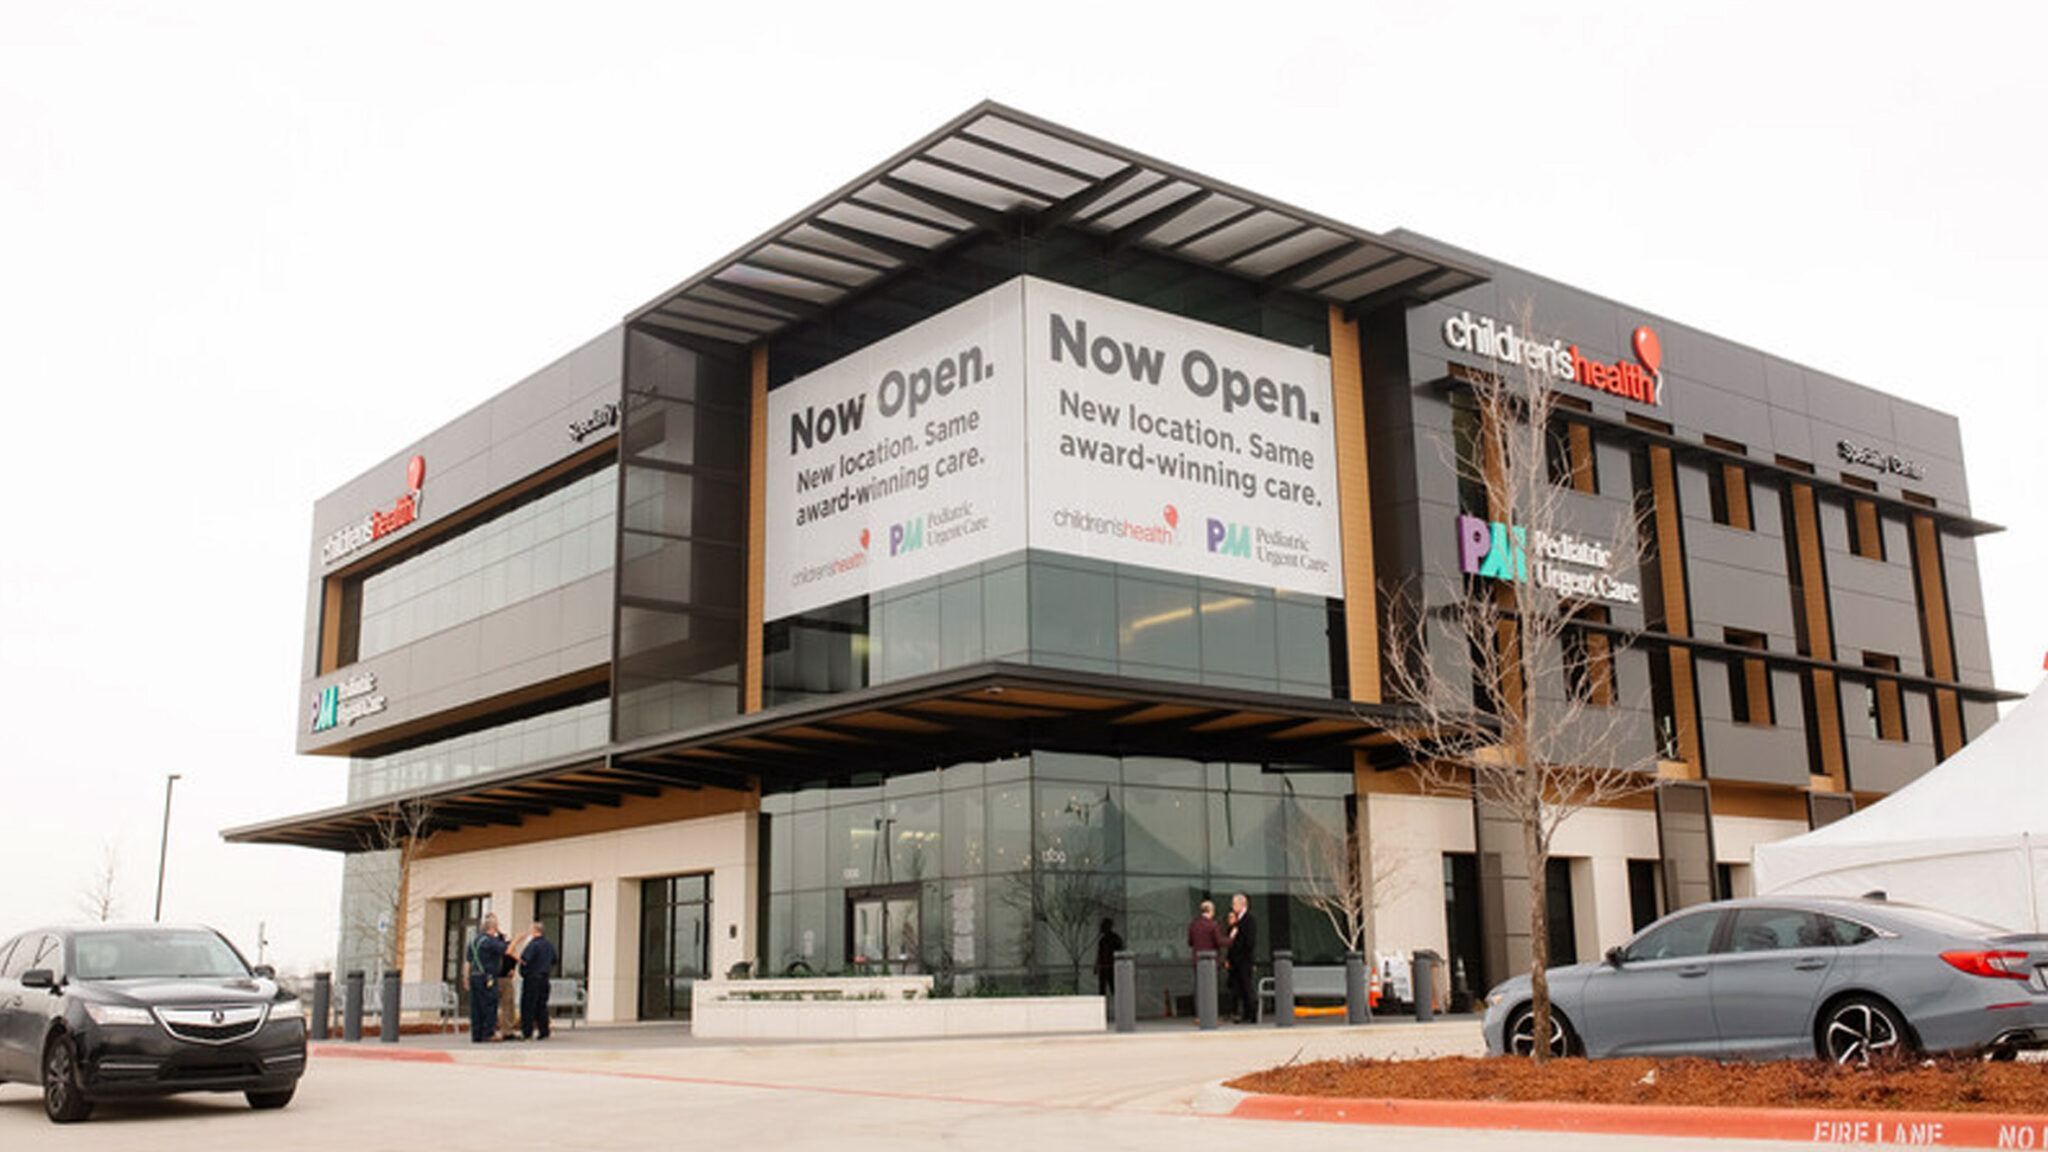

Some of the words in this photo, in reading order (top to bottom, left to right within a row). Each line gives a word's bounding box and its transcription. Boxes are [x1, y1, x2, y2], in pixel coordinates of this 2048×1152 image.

[789, 393, 866, 455] Now
[877, 345, 994, 418] Open.
[1049, 313, 1165, 386] Now
[1181, 349, 1320, 425] Open.
[796, 464, 835, 494] New
[839, 431, 919, 479] location.
[925, 409, 980, 447] Same
[1059, 389, 1120, 427] New
[1129, 404, 1242, 455] location.
[1249, 433, 1314, 470] Same
[795, 462, 930, 527] award-winning
[935, 446, 985, 479] care.
[1059, 434, 1257, 499] award-winning
[1264, 476, 1323, 508] care.
[962, 515, 989, 535] Care
[1256, 526, 1309, 553] Pediatric
[1256, 546, 1298, 568] Urgent
[1299, 554, 1329, 573] Care
[1598, 574, 1640, 604] Care
[1813, 1121, 1869, 1142] FIRE
[1876, 1122, 1944, 1146] LANE
[1997, 1124, 2035, 1150] NO
